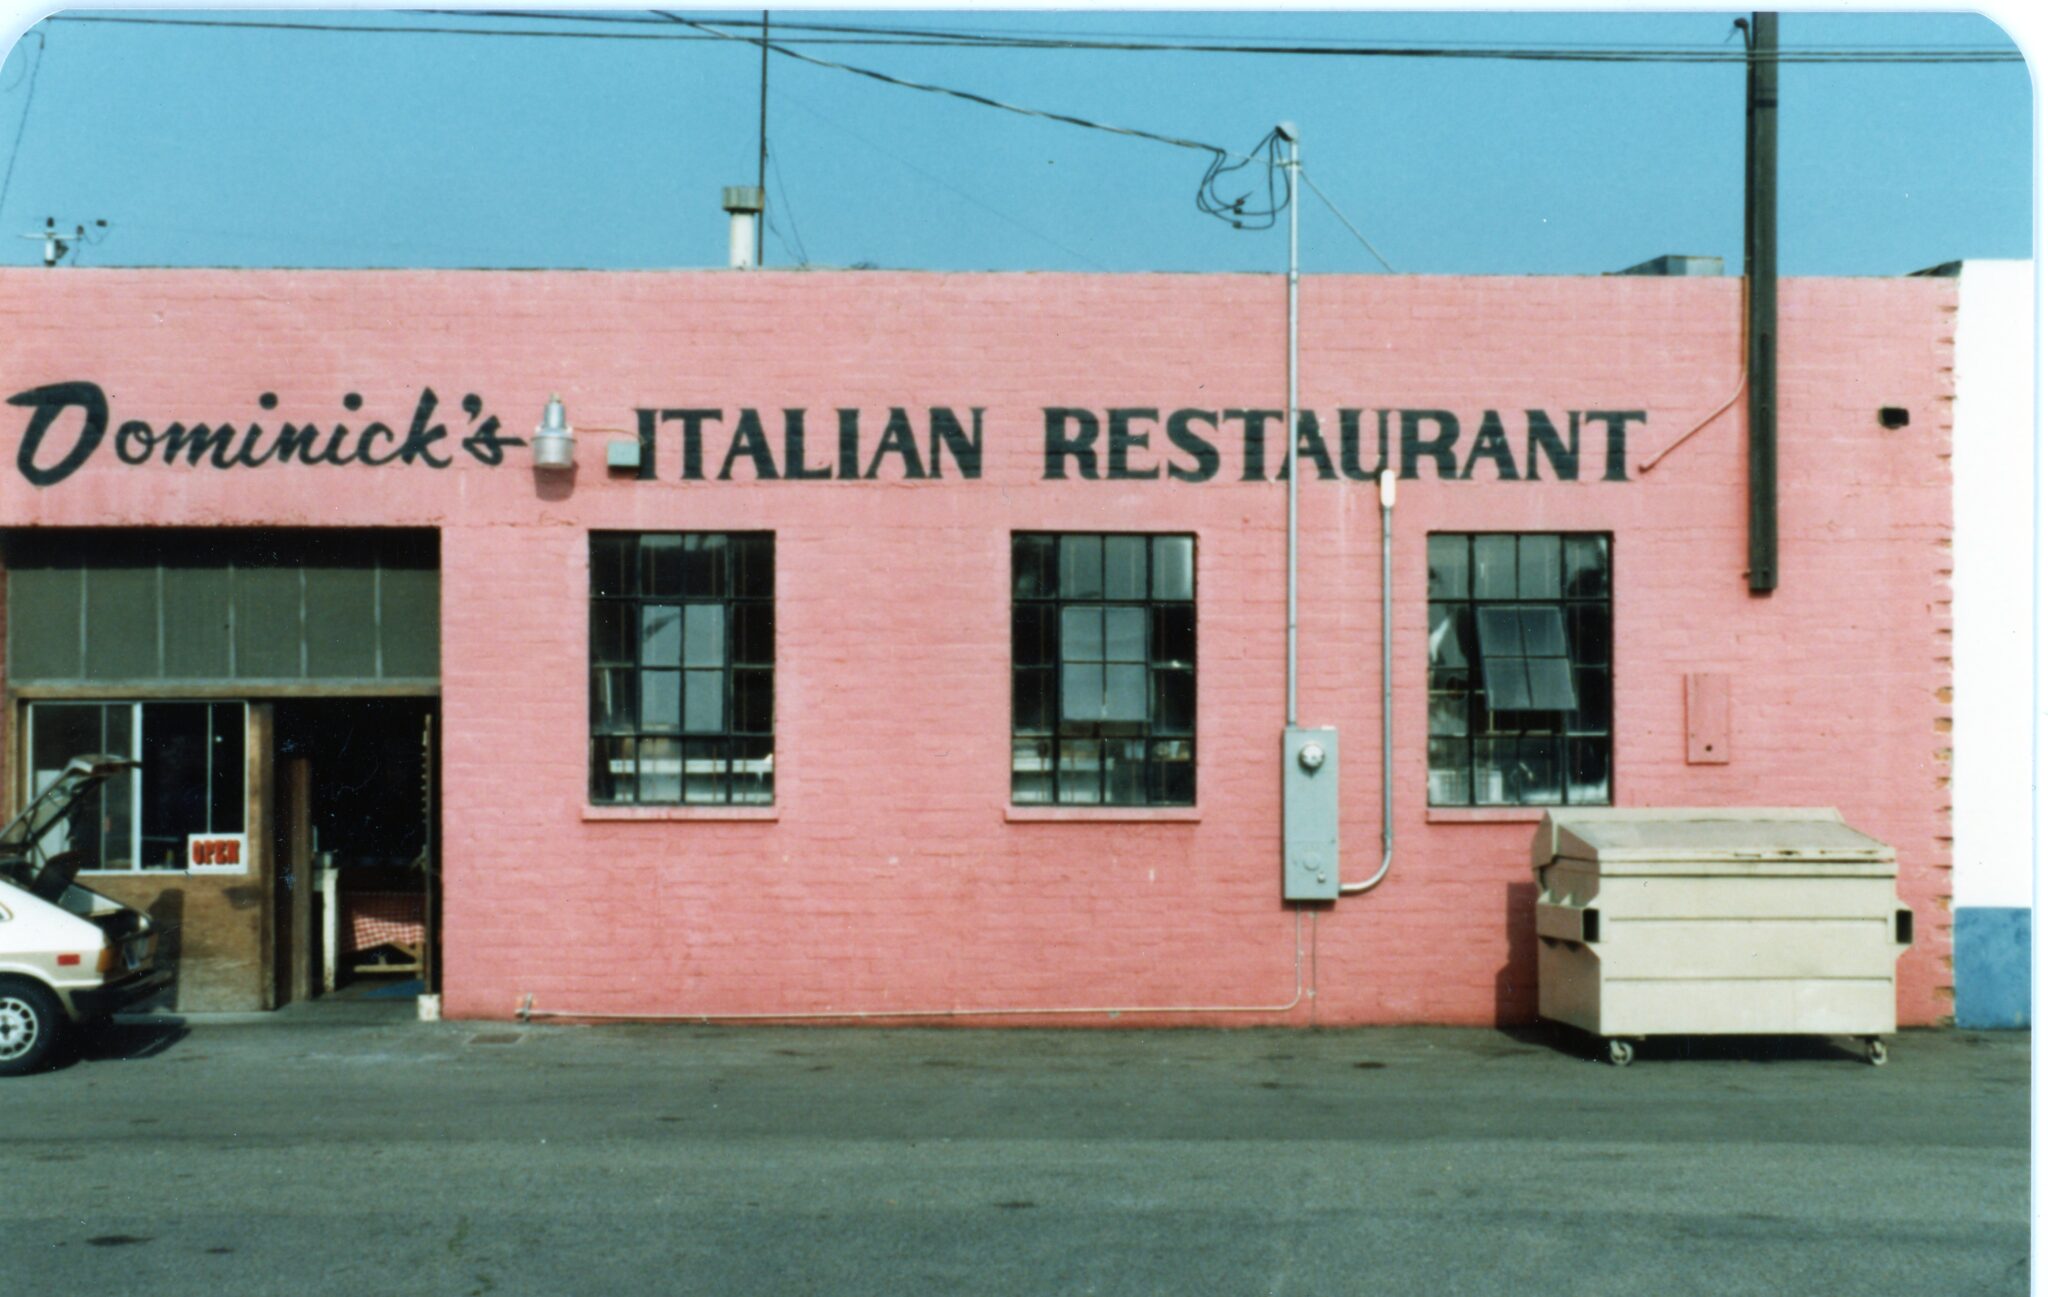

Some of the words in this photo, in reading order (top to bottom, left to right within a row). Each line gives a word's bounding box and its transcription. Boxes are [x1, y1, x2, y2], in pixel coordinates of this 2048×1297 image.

[7, 381, 527, 486] Dominick's
[633, 408, 985, 480] ITALIAN
[1042, 407, 1646, 481] RESTAURANT
[192, 839, 240, 866] OPEN
